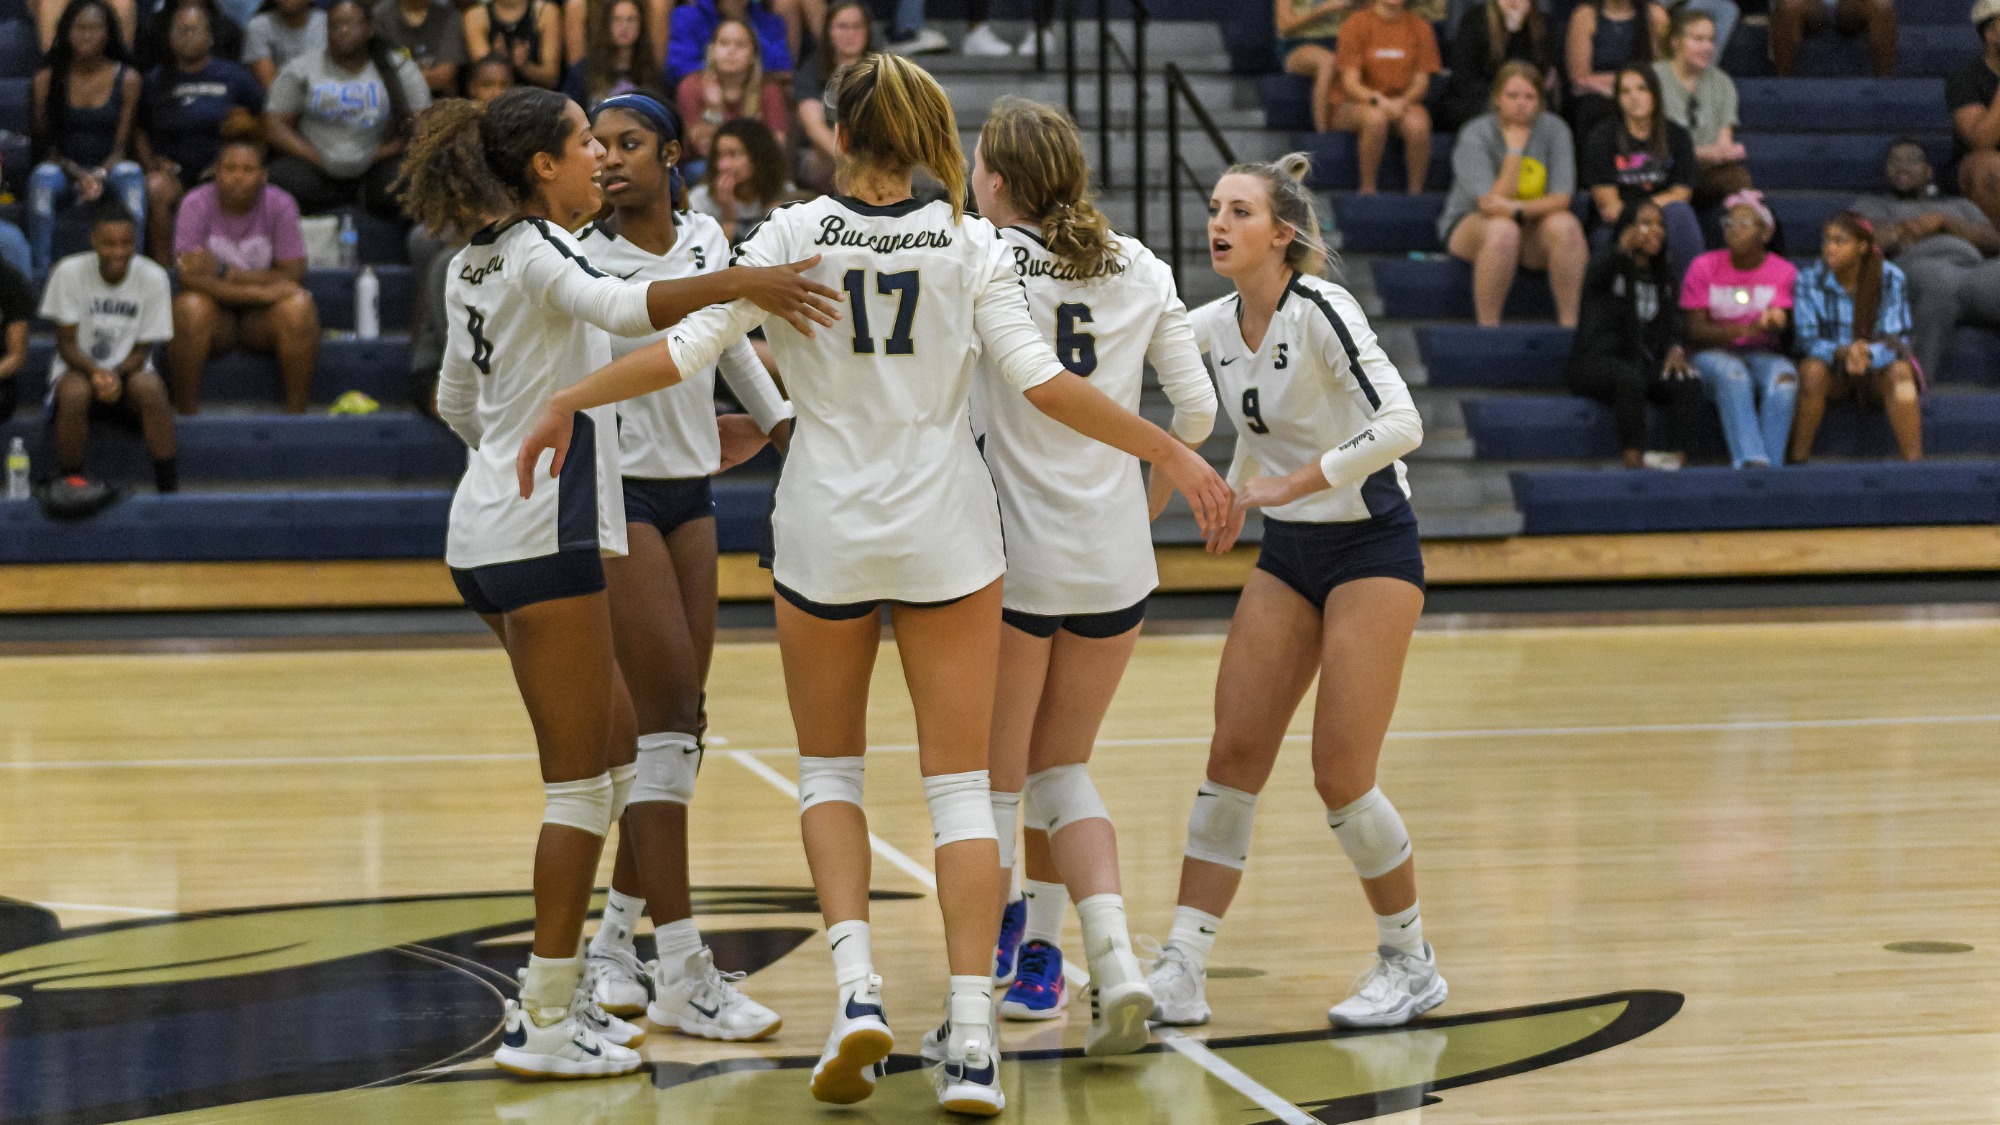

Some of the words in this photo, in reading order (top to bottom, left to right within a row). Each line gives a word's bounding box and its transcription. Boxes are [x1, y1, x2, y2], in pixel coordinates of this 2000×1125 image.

[814, 214, 952, 254] Buccaneers
[841, 267, 921, 355] 17
[1055, 302, 1098, 378] 6
[1241, 387, 1270, 434] 9
